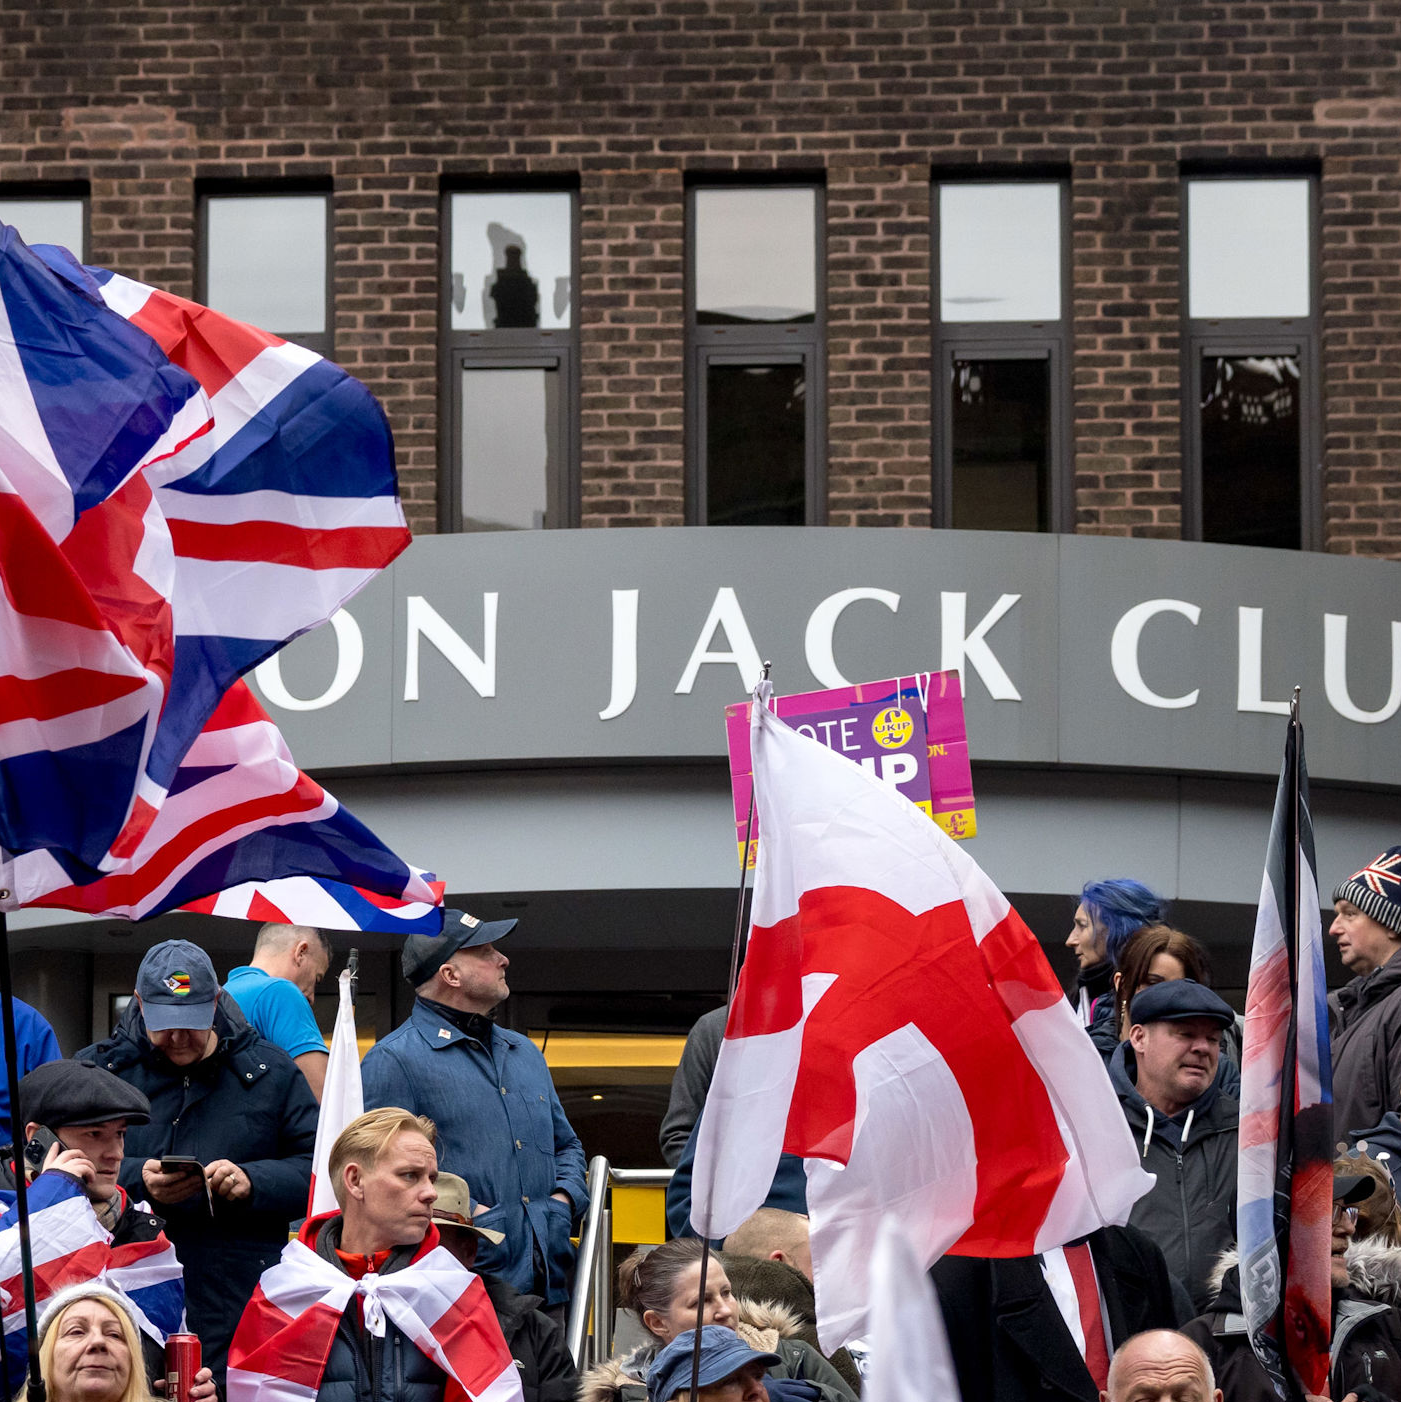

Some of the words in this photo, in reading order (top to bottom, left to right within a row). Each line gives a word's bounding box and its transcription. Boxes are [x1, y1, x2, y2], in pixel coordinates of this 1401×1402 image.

[254, 591, 498, 712] ON
[598, 586, 1023, 721] JACK
[796, 717, 861, 752] OTE
[874, 721, 911, 733] UKIP
